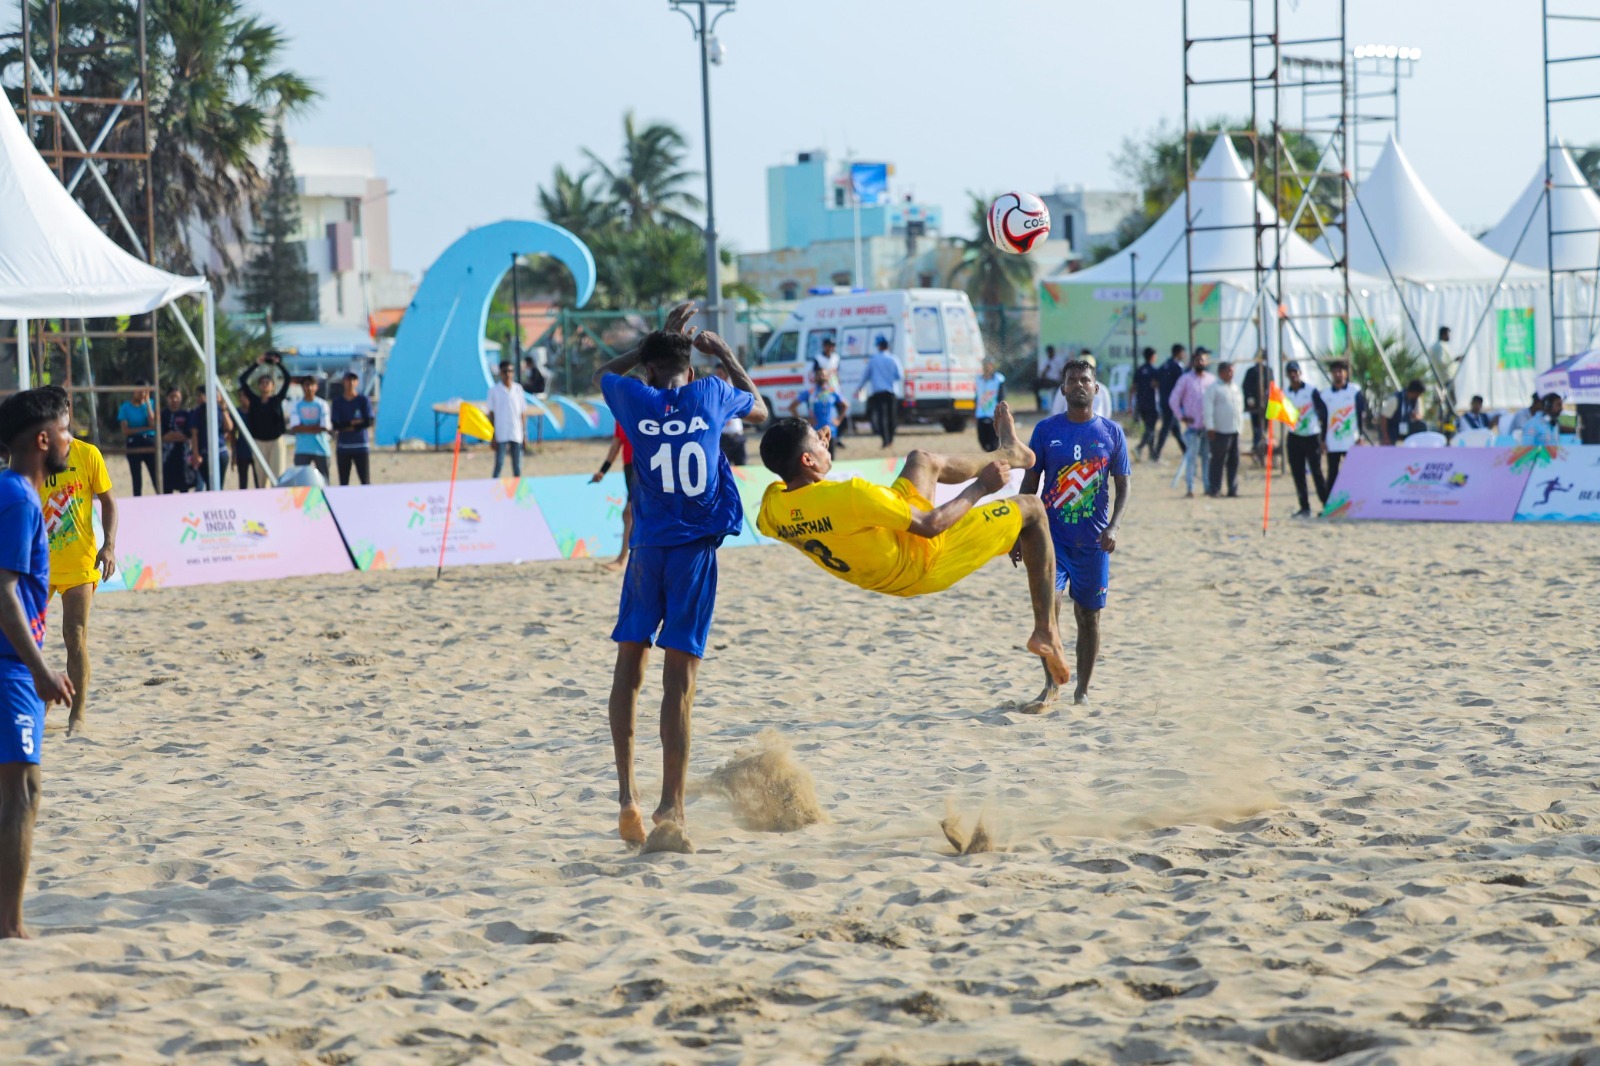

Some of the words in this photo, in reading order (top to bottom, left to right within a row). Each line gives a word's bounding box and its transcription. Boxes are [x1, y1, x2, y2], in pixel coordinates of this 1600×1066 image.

[638, 416, 709, 436] GOA
[1073, 444, 1082, 461] 8
[650, 441, 707, 497] 10
[203, 508, 237, 521] KHELO
[992, 505, 1011, 518] 8
[206, 521, 236, 533] INDIA
[21, 727, 35, 755] 5
